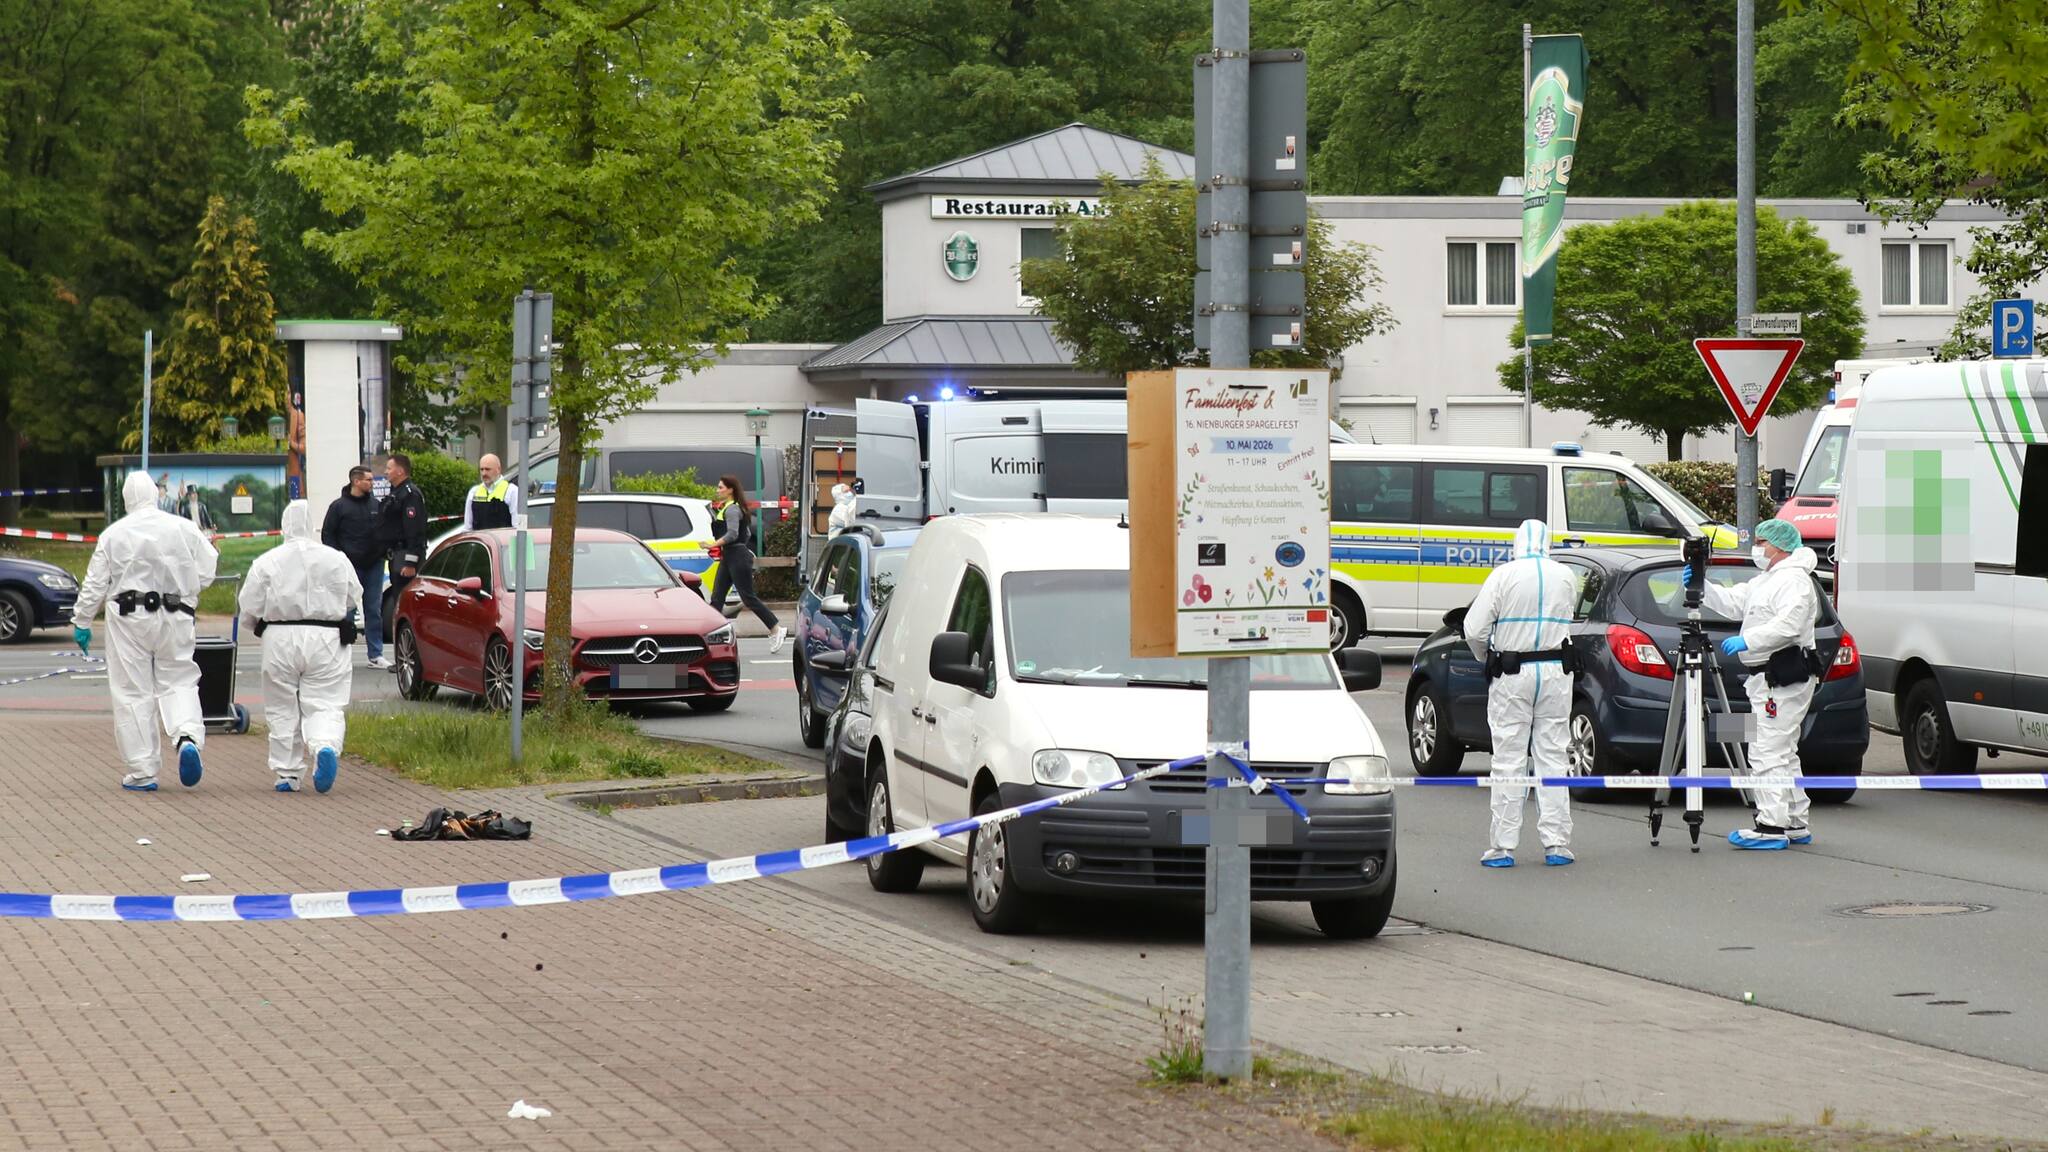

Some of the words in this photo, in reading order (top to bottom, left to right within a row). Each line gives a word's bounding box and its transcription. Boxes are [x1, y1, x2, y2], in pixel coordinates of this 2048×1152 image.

[945, 199, 1071, 215] Restaurant
[2003, 307, 2024, 349] P
[1185, 388, 1259, 417] Familienfest
[1196, 419, 1245, 430] NIENBURGER
[1246, 419, 1299, 430] SPARGELFEST
[1237, 440, 1252, 450] MAI
[1253, 440, 1274, 450] 2026
[1242, 458, 1249, 466] 17
[1252, 457, 1267, 466] UHR
